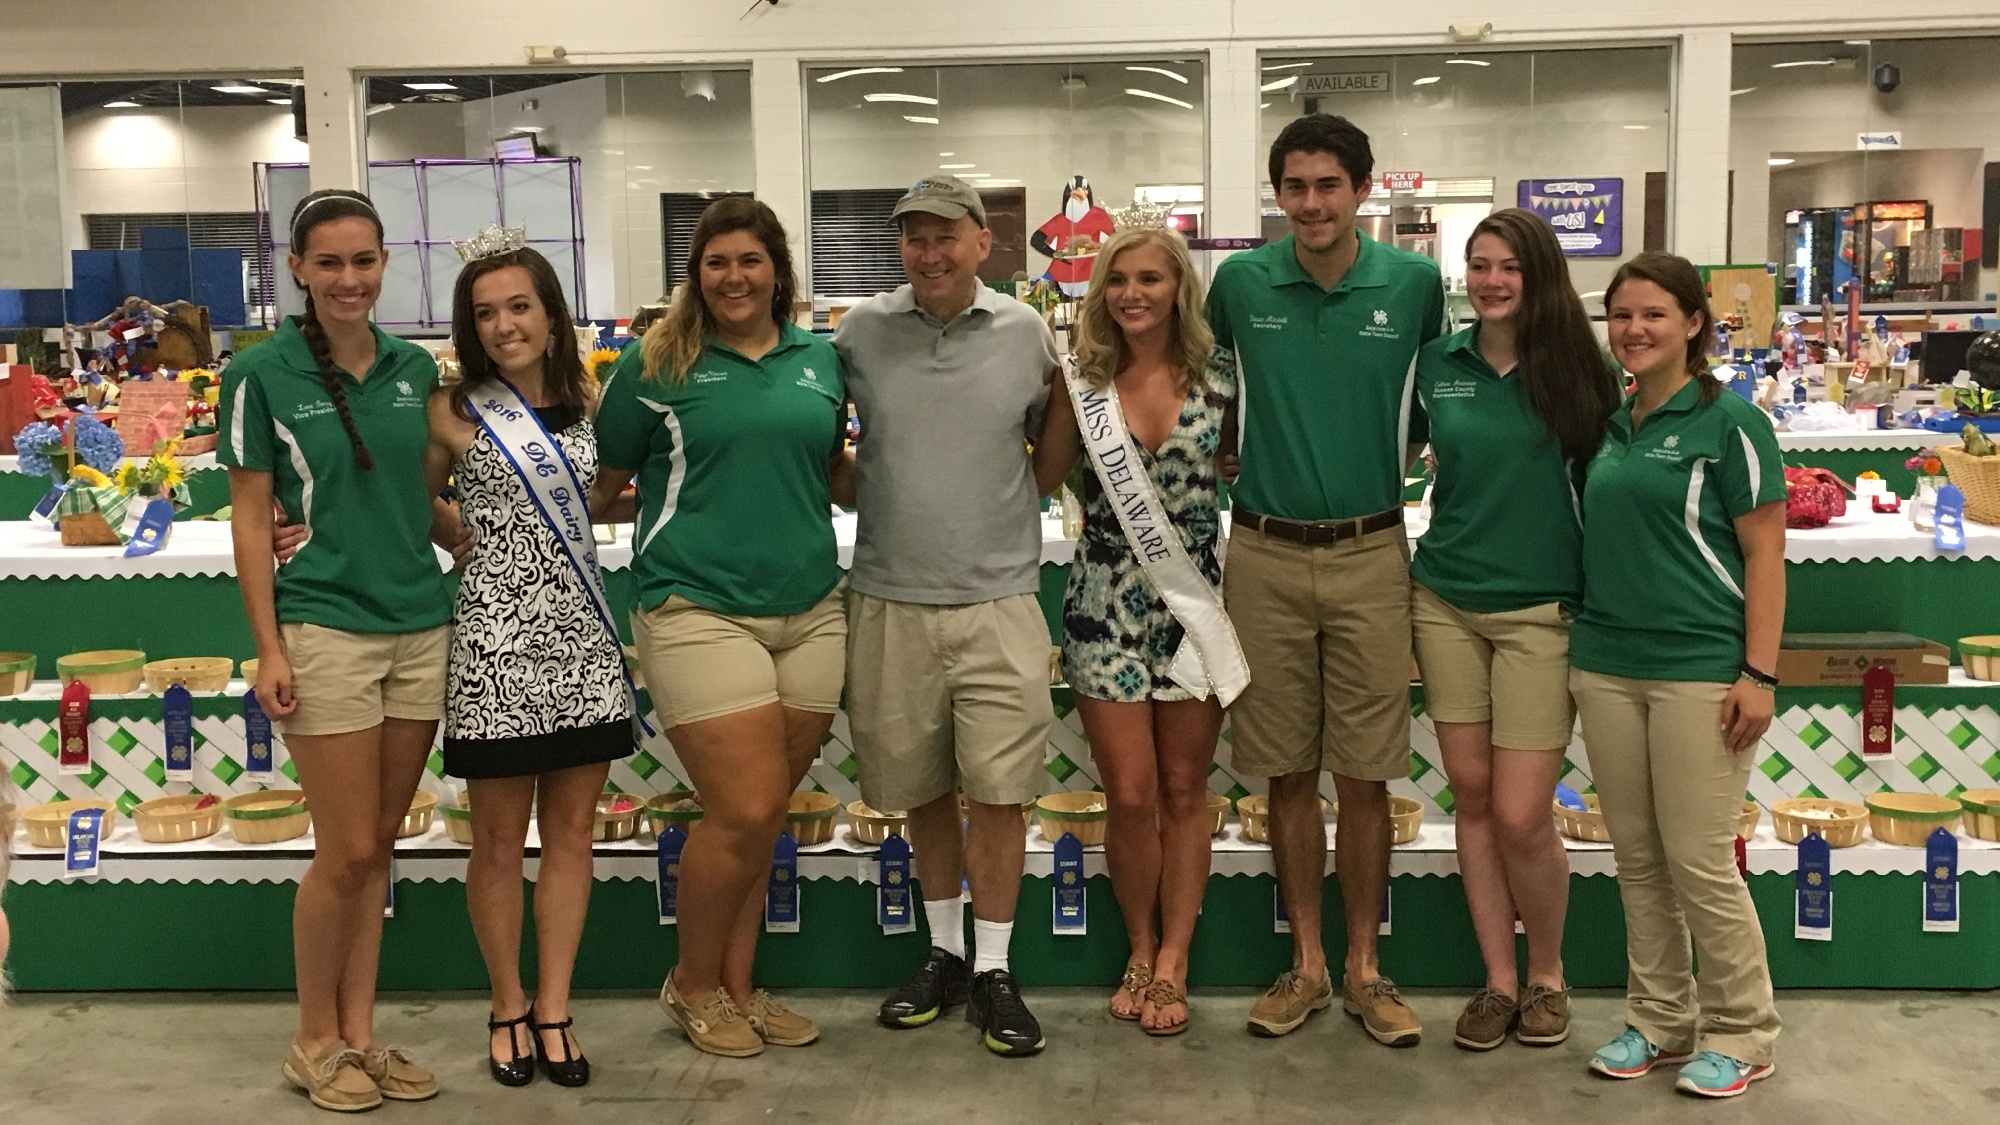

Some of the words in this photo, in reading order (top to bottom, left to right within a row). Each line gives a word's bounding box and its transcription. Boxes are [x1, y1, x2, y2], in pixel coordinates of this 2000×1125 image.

[1306, 76, 1379, 90] AVAILABLE
[1385, 172, 1406, 181] PICK
[1407, 172, 1420, 180] UP
[1391, 181, 1414, 189] HERE
[1253, 322, 1283, 330] Secretary
[293, 411, 309, 420] Vice
[483, 399, 523, 422] 2016
[521, 441, 559, 478] DE
[549, 486, 585, 545] Dairy
[1079, 387, 1113, 443] MISS
[1098, 444, 1173, 564] DELAWARE
